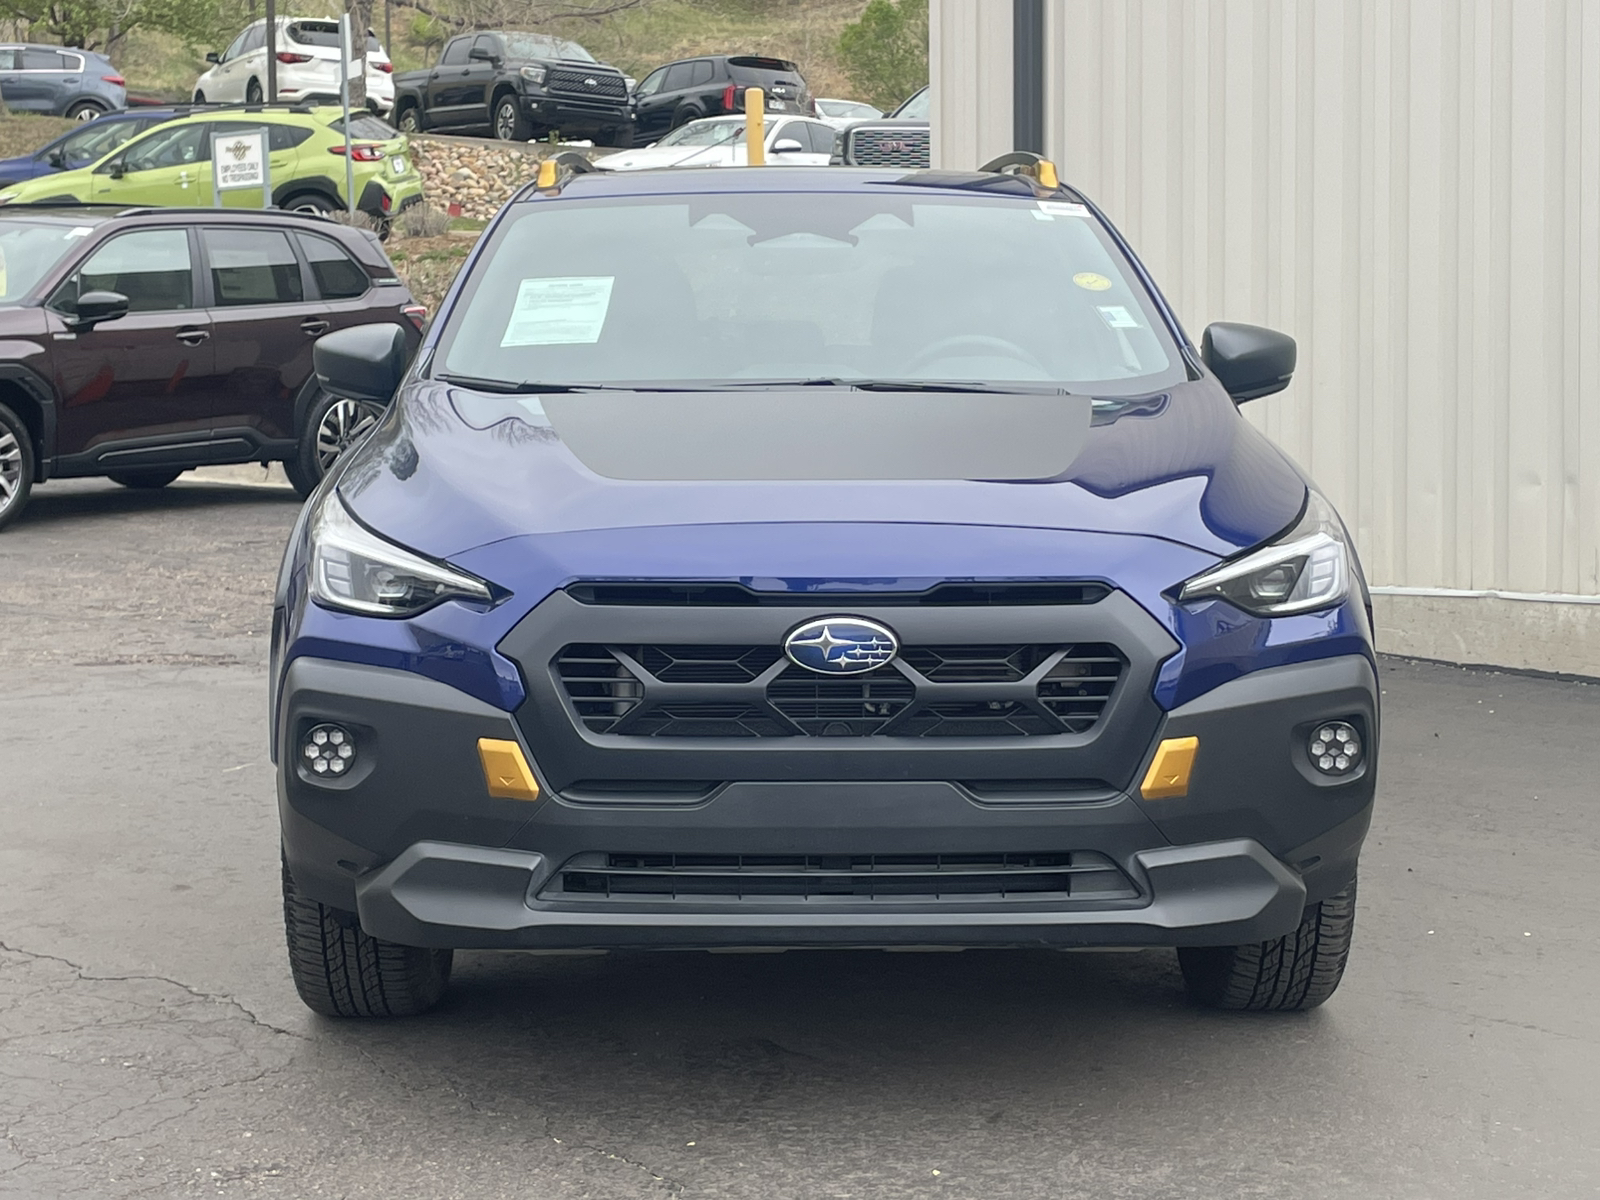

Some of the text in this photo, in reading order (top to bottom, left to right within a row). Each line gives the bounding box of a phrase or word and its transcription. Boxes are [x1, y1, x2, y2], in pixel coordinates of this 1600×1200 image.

[879, 141, 913, 152] GMC
[247, 162, 259, 171] ONLY
[222, 175, 228, 183] NO
